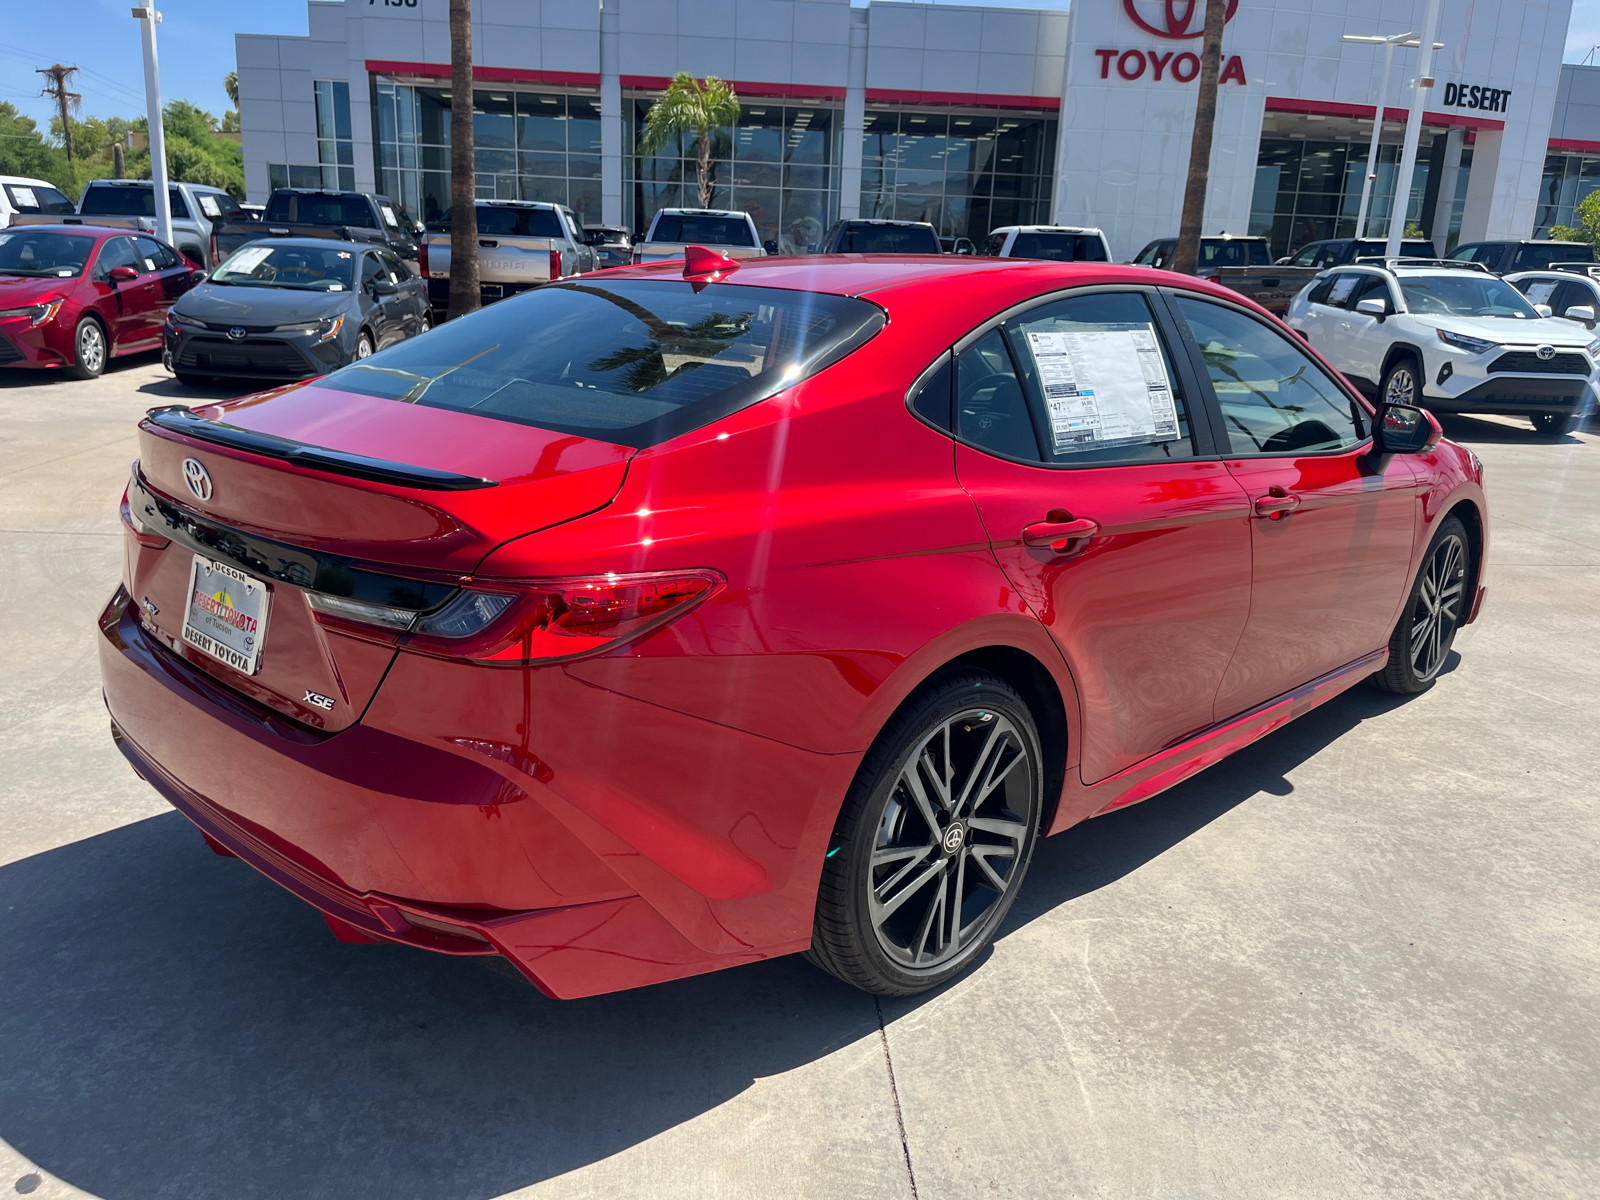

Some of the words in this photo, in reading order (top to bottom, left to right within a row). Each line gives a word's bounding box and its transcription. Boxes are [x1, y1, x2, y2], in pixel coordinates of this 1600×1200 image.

[1095, 49, 1247, 85] TOYOA
[1444, 82, 1512, 113] DESERT
[210, 561, 246, 583] TUCSON
[193, 589, 222, 617] DESERT
[223, 606, 258, 635] TOYOTA
[205, 615, 213, 624] of
[213, 617, 232, 636] Tucson
[184, 626, 213, 653] DESERT
[214, 641, 249, 672] TOYOTA
[303, 690, 335, 711] XSE
